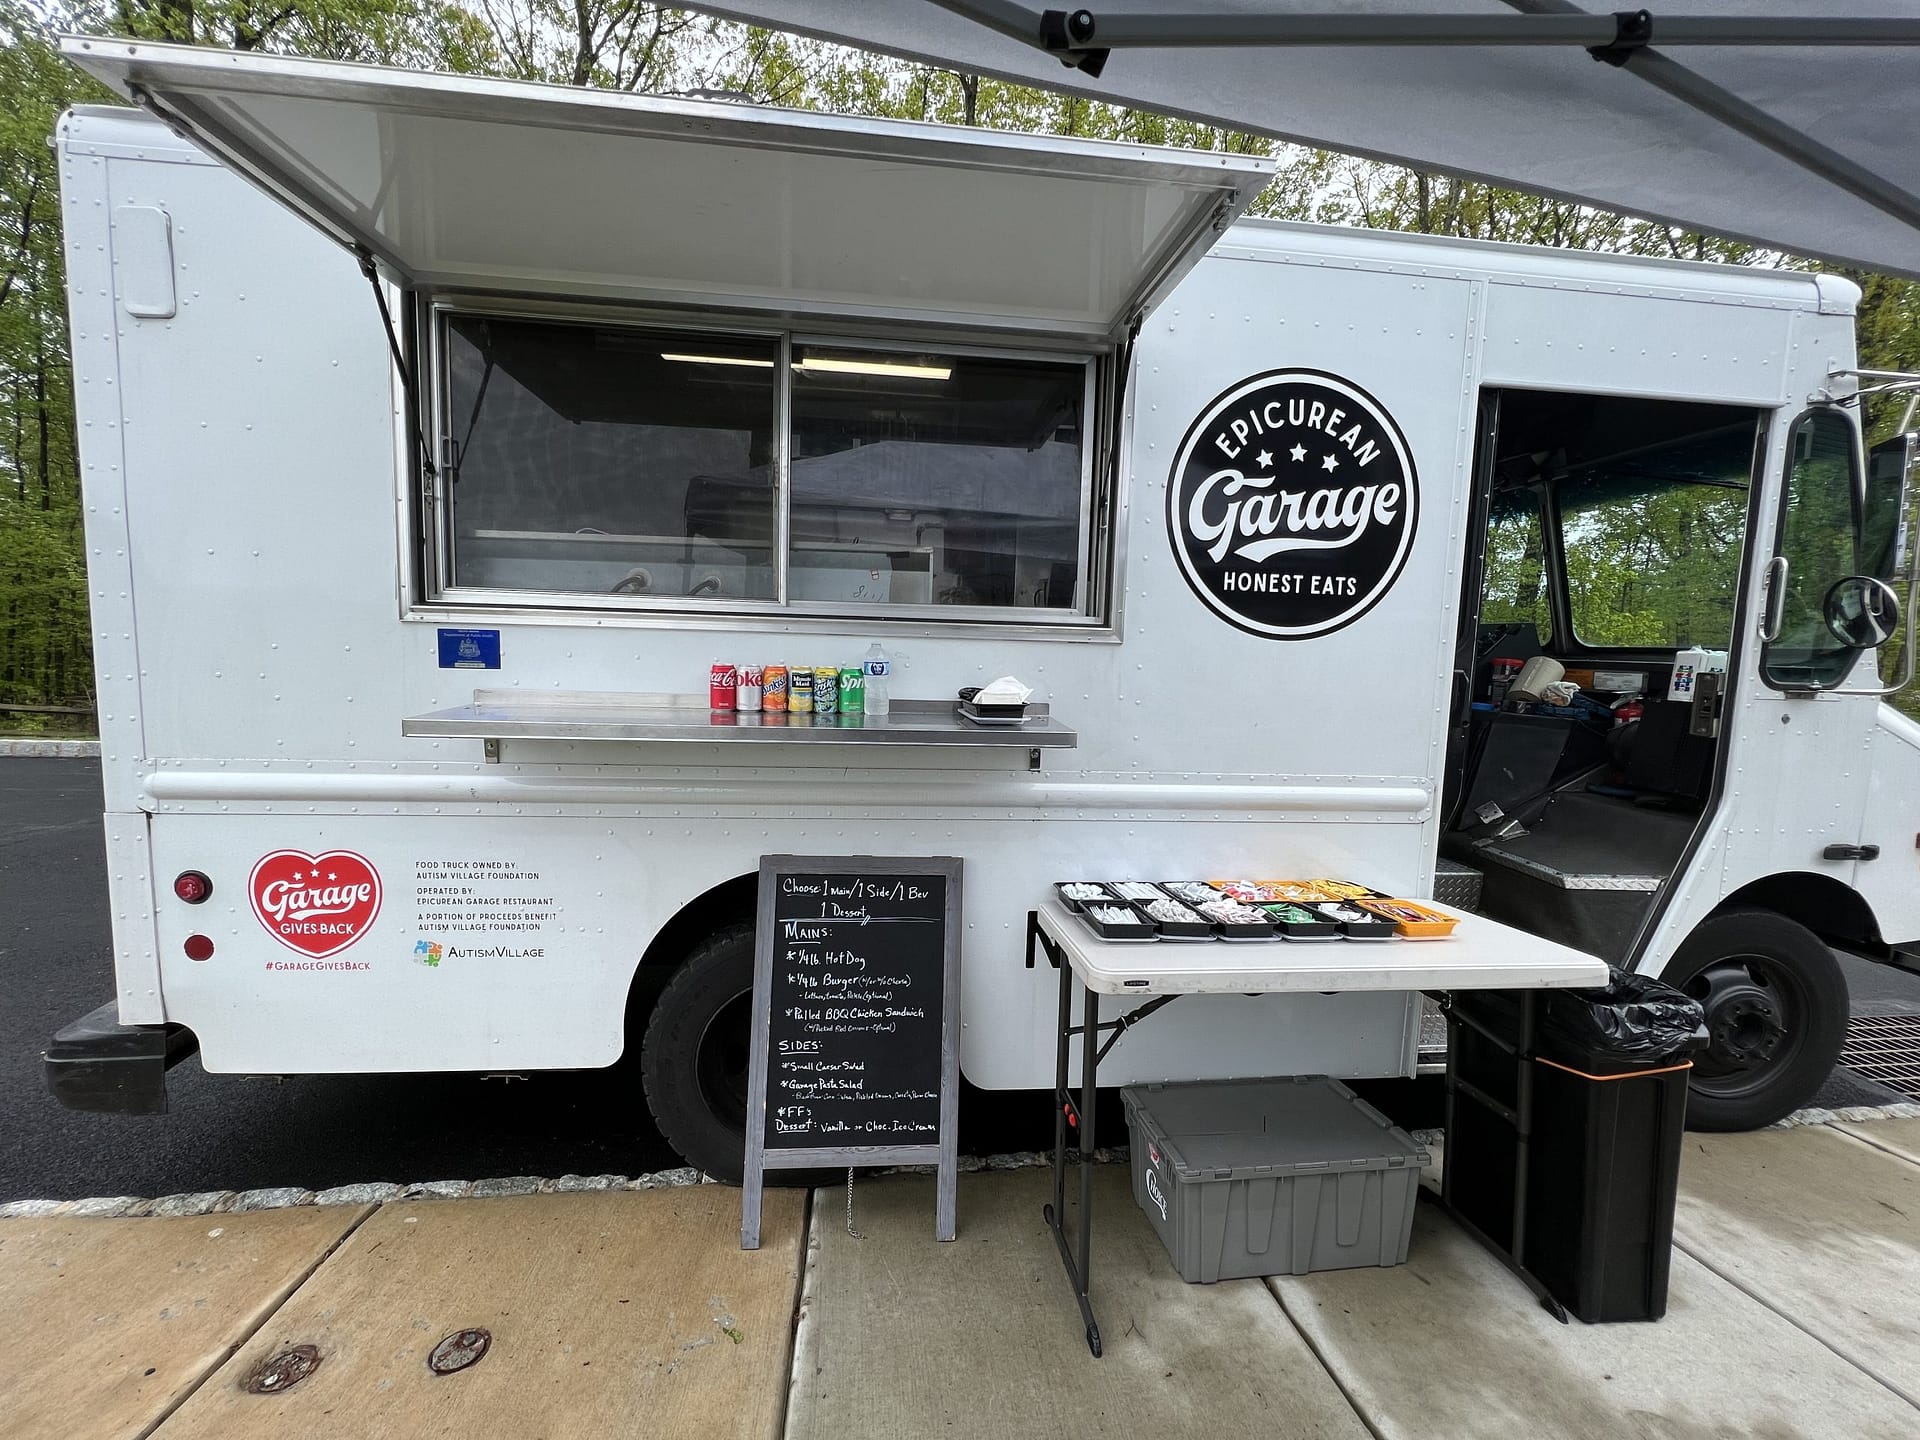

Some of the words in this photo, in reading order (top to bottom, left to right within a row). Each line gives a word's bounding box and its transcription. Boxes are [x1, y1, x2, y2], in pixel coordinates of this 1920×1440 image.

[1215, 399, 1381, 467] EPICUREAN
[1189, 469, 1400, 564] Garage
[1223, 572, 1304, 594] HONEST
[1310, 576, 1357, 596] EATS
[415, 861, 439, 869] FOOD
[416, 872, 447, 880] AUTISM
[450, 872, 485, 880] VILLAGE
[416, 887, 459, 895] OPERATED
[783, 878, 821, 894] Choose:
[908, 886, 929, 899] Bev
[262, 880, 371, 922] Garage
[830, 902, 867, 918] Dessert
[280, 923, 317, 935] GIVES
[320, 923, 355, 935] BACK
[418, 923, 449, 931] AUTISM
[452, 923, 487, 931] VILLAGE
[785, 921, 833, 940] MAINS:
[823, 972, 858, 992] Burger
[794, 1006, 821, 1021] Pulled
[825, 1007, 849, 1021] BBQ
[850, 1007, 883, 1019] Chicken
[885, 1006, 925, 1019] Sandwich
[778, 1040, 823, 1051] SIDES:
[790, 1061, 814, 1072] Small
[788, 1079, 818, 1094] Garage
[818, 1078, 838, 1090] Pasta
[838, 1078, 864, 1090] Salad
[820, 1120, 851, 1133] Vanilla
